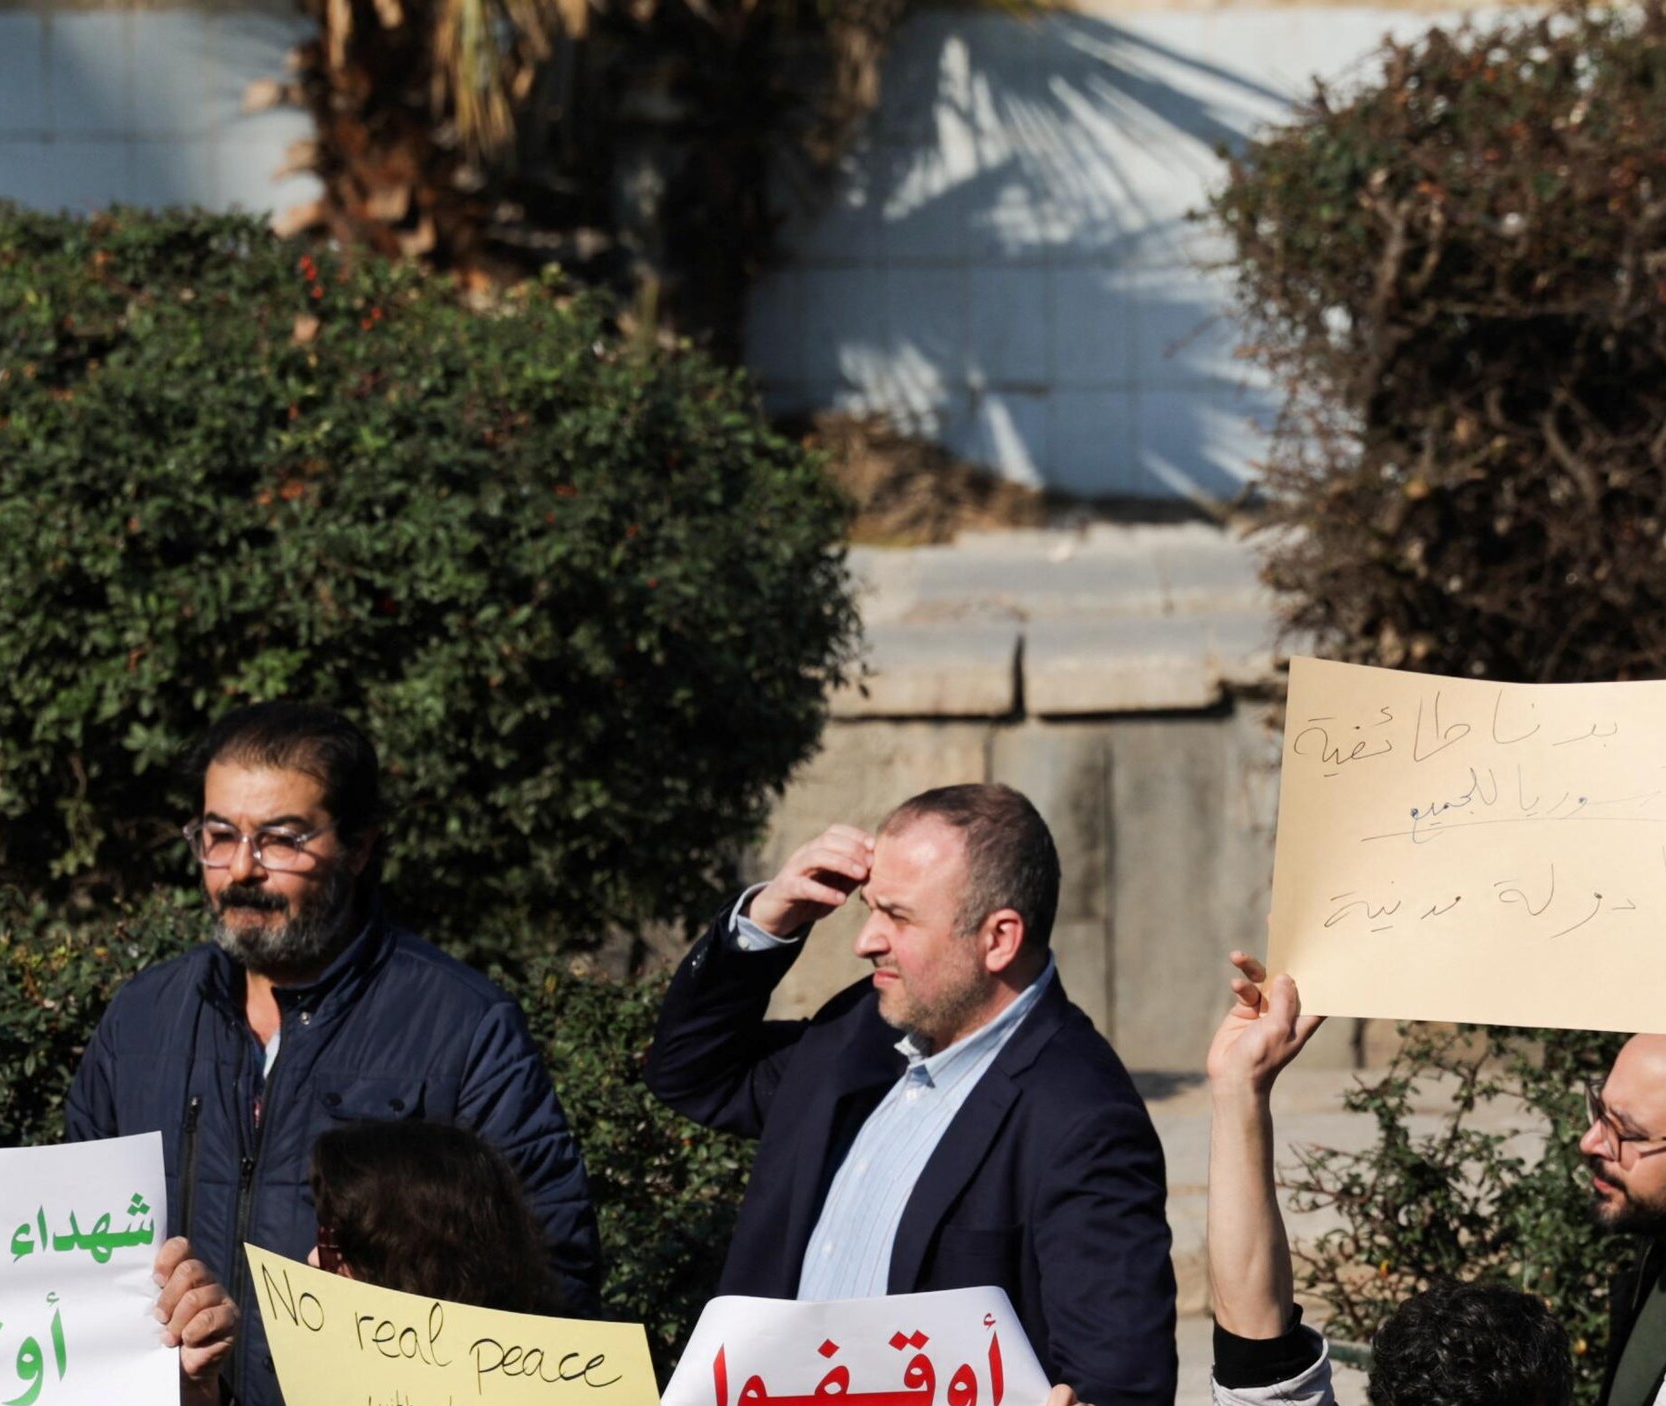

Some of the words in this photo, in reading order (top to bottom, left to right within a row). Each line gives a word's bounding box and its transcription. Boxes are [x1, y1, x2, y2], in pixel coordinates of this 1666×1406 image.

[9, 1191, 155, 1265] شهداء
[261, 1263, 325, 1332] No
[354, 1302, 453, 1367] real
[468, 1338, 623, 1395] peace
